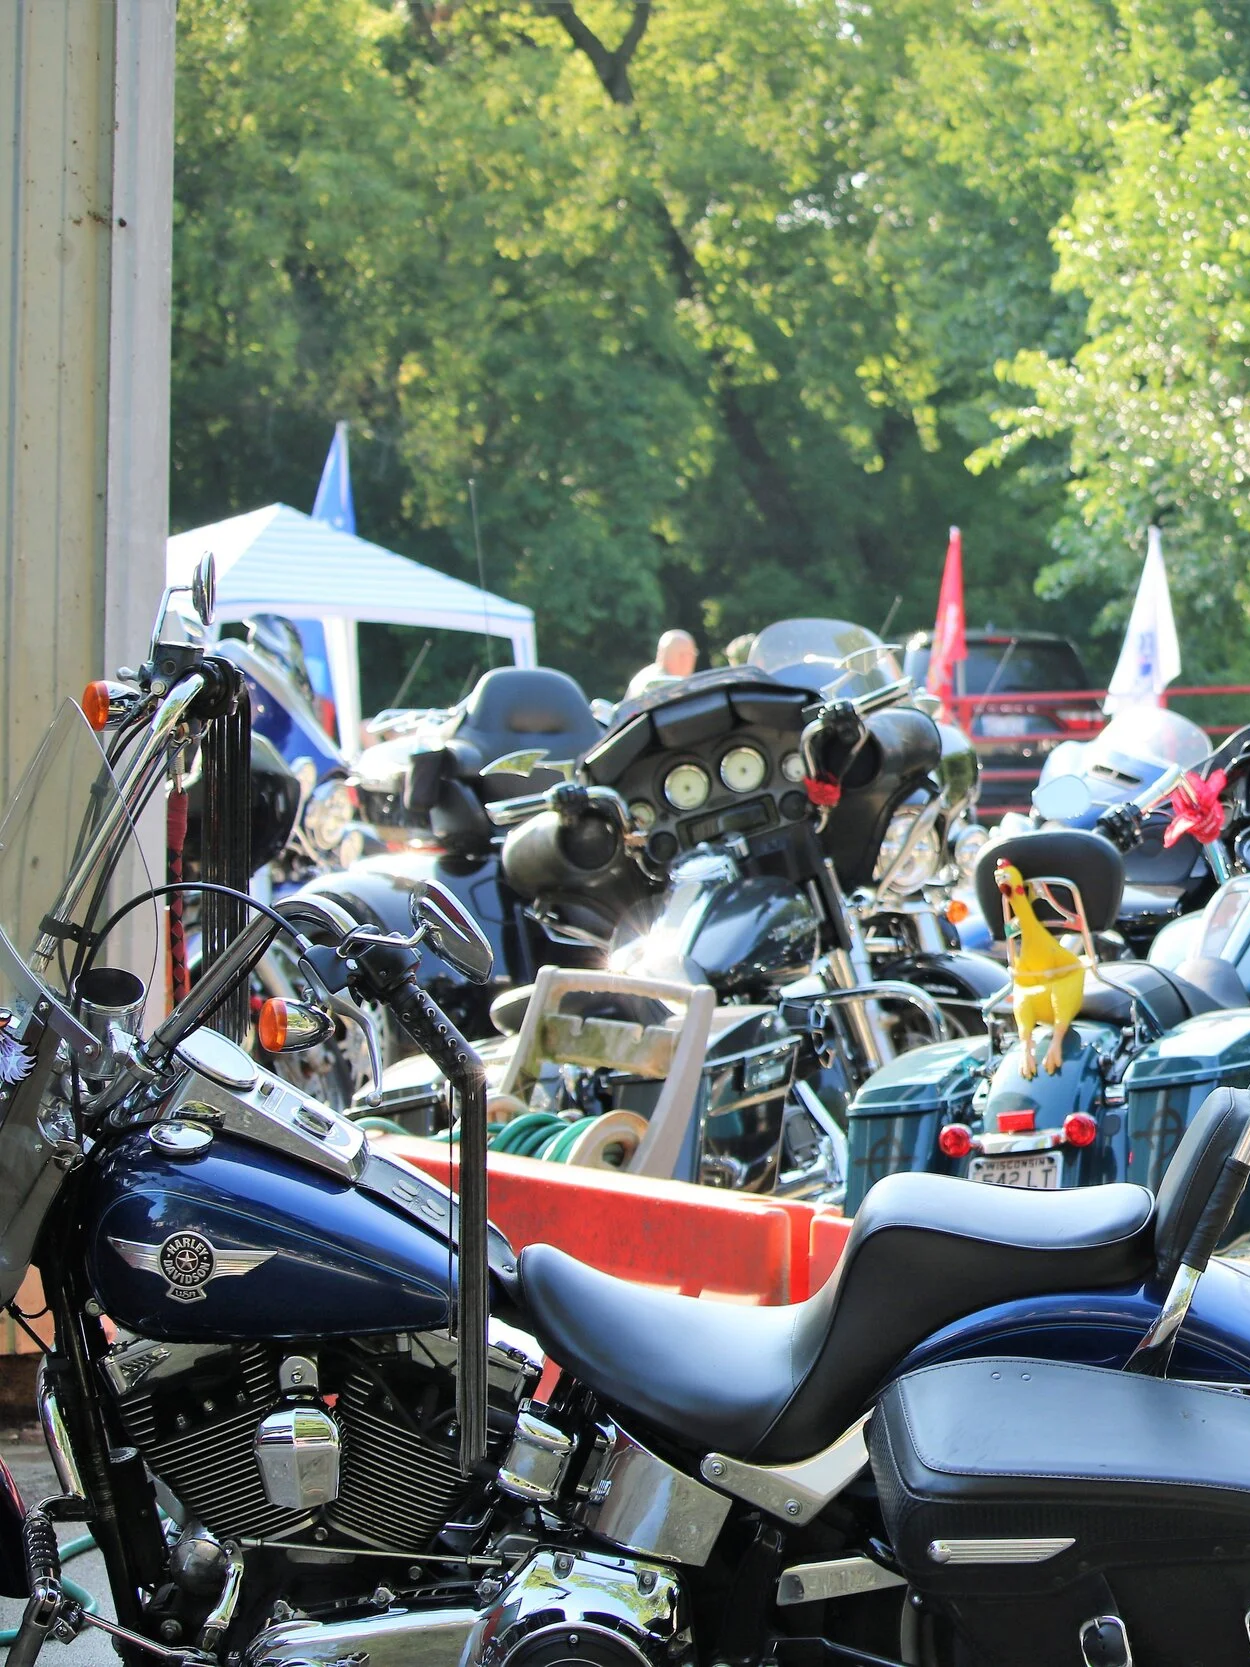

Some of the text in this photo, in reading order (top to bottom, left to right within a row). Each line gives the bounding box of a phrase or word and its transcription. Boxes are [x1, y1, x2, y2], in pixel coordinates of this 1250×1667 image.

[983, 1159, 1045, 1171] WISCONSIN
[167, 1237, 211, 1257] HARLEY
[163, 1259, 211, 1285] DAVIDSON
